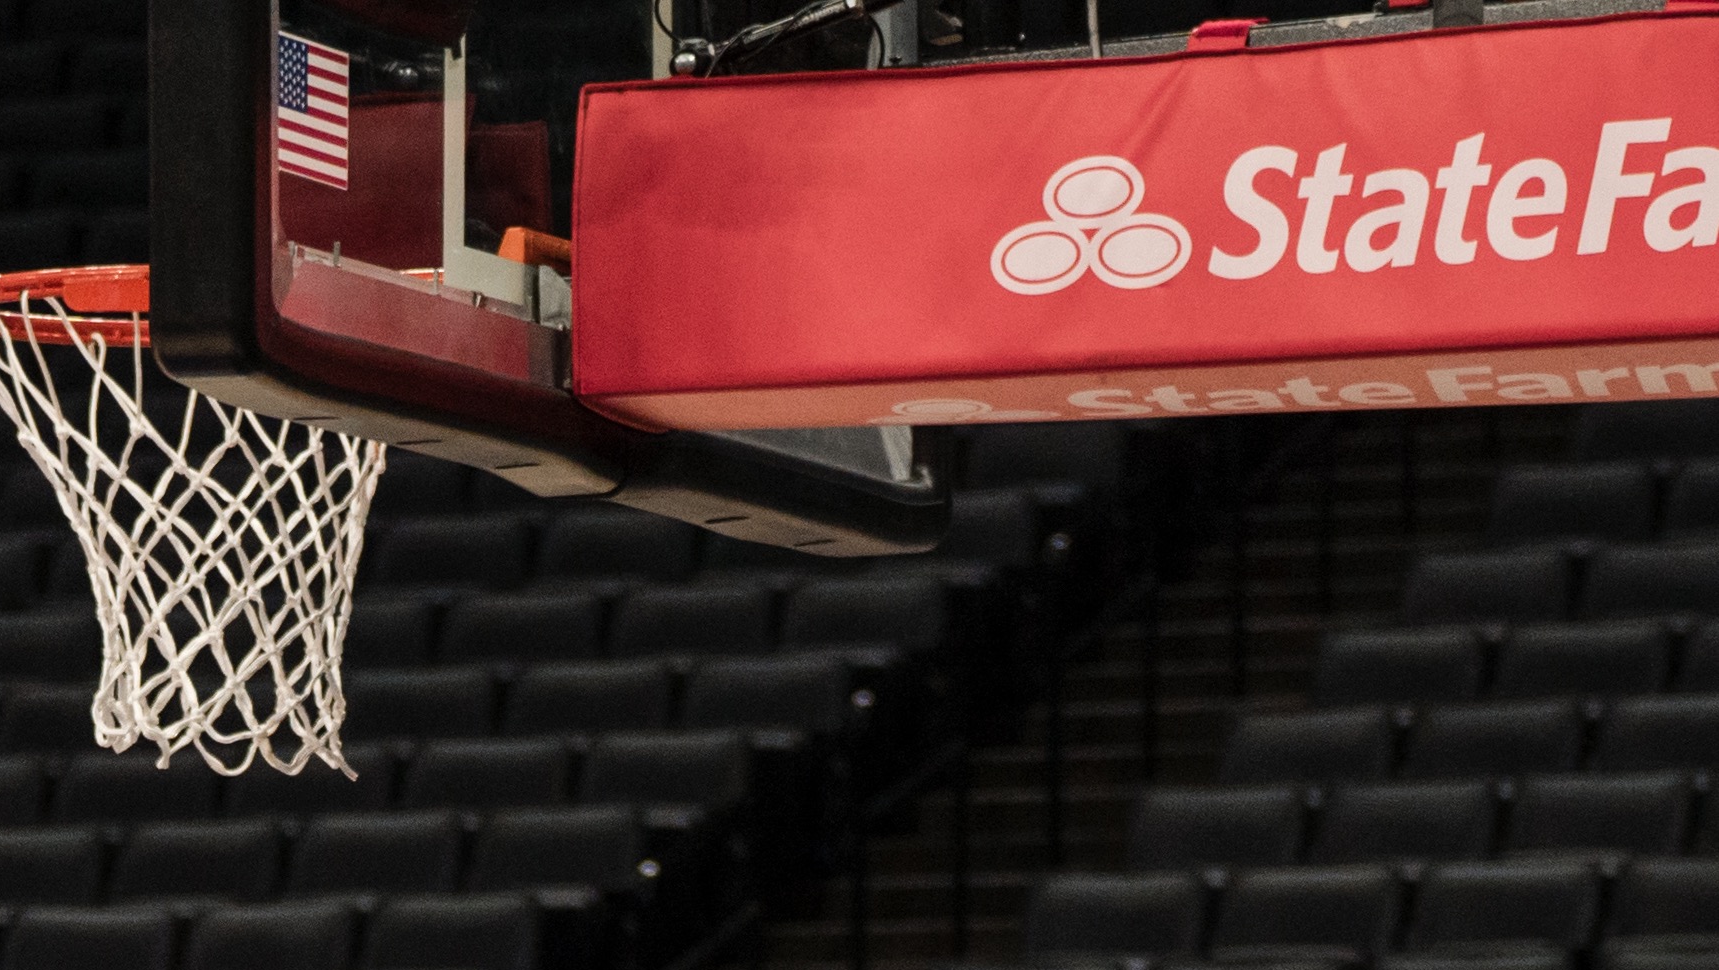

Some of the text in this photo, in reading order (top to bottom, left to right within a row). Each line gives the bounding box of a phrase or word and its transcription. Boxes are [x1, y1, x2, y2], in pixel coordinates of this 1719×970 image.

[1208, 132, 1567, 280] State
[1068, 363, 1719, 416] State Farm
